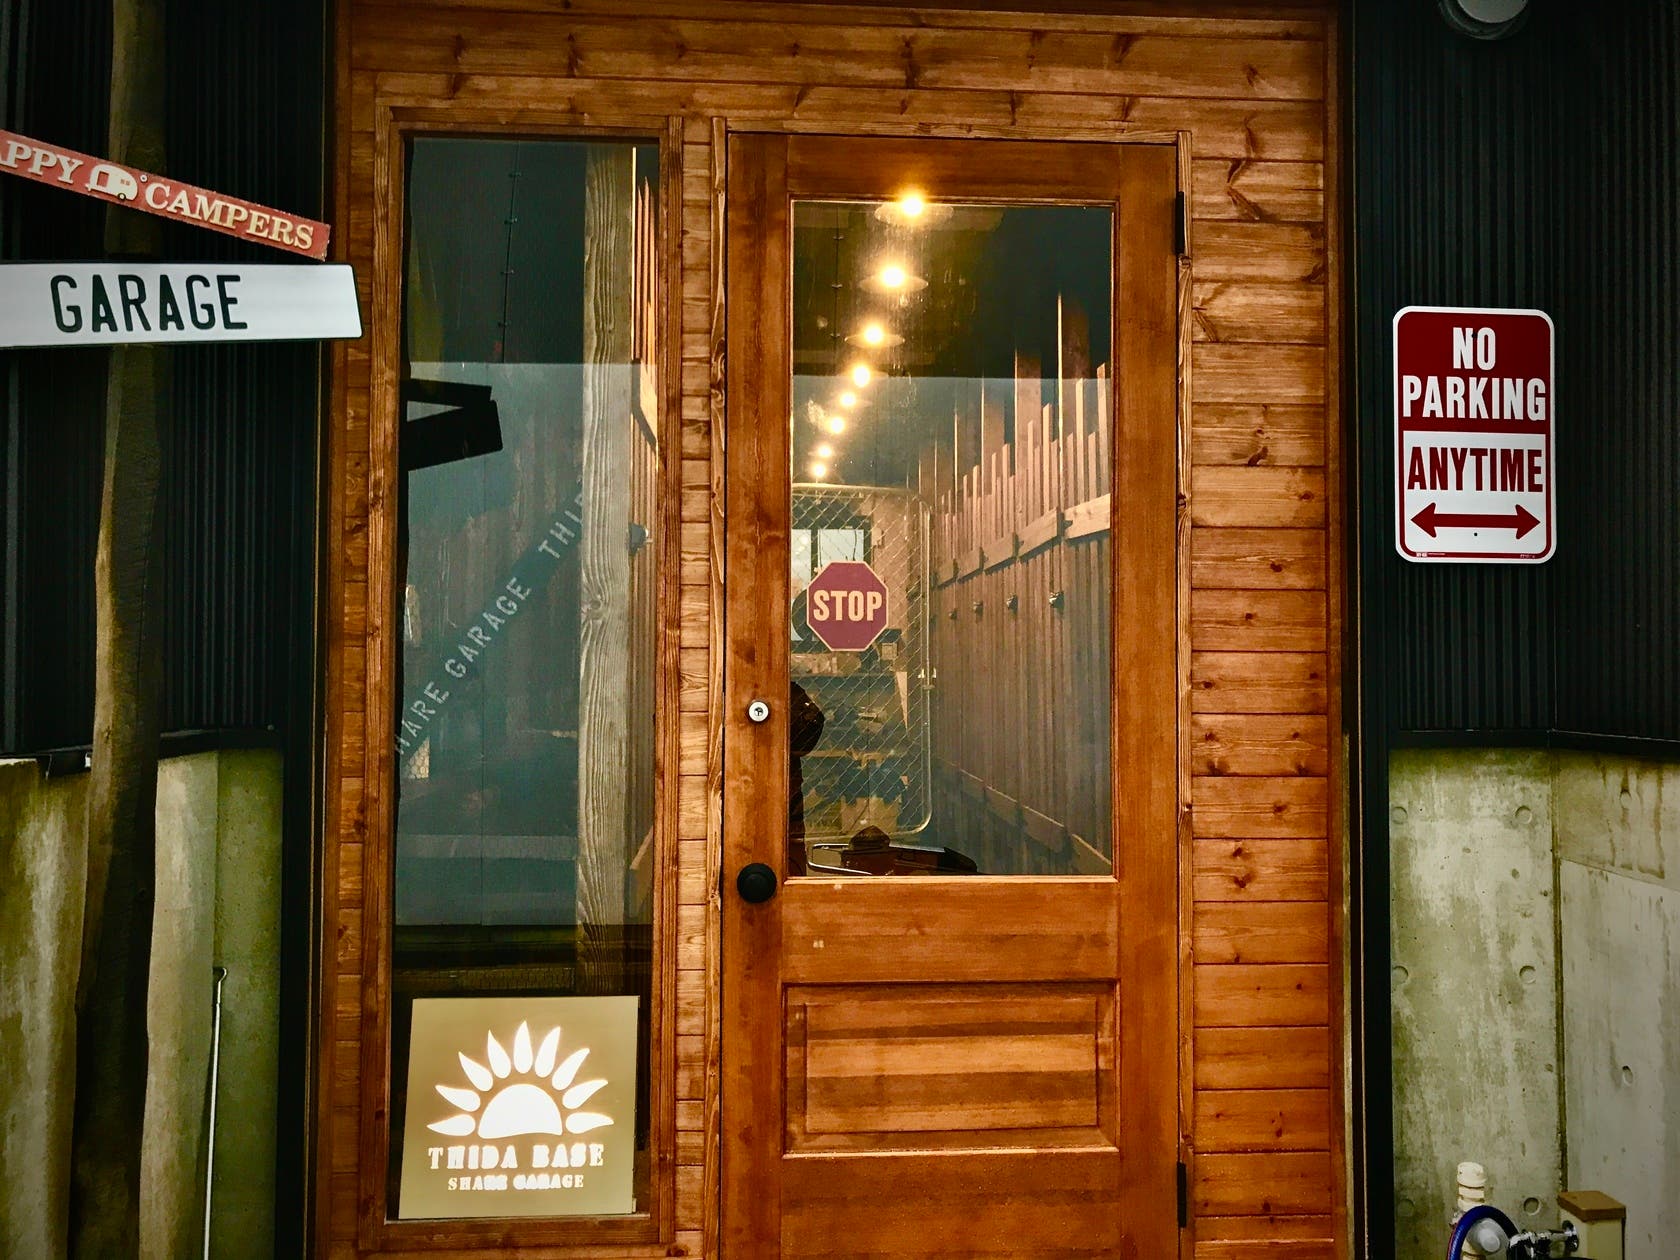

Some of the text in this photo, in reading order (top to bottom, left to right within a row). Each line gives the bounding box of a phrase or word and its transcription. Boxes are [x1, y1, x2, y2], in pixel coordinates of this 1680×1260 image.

[0, 140, 314, 250] PPY CAMPERS
[50, 274, 248, 333] GARAGE
[1453, 327, 1496, 371] NO
[1403, 375, 1546, 421] PARKING
[1407, 446, 1543, 492] ANYTIME
[445, 577, 532, 678] GARAGE
[538, 493, 583, 559] THI
[813, 590, 882, 622] STOP
[428, 1143, 604, 1169] THIDA BASE
